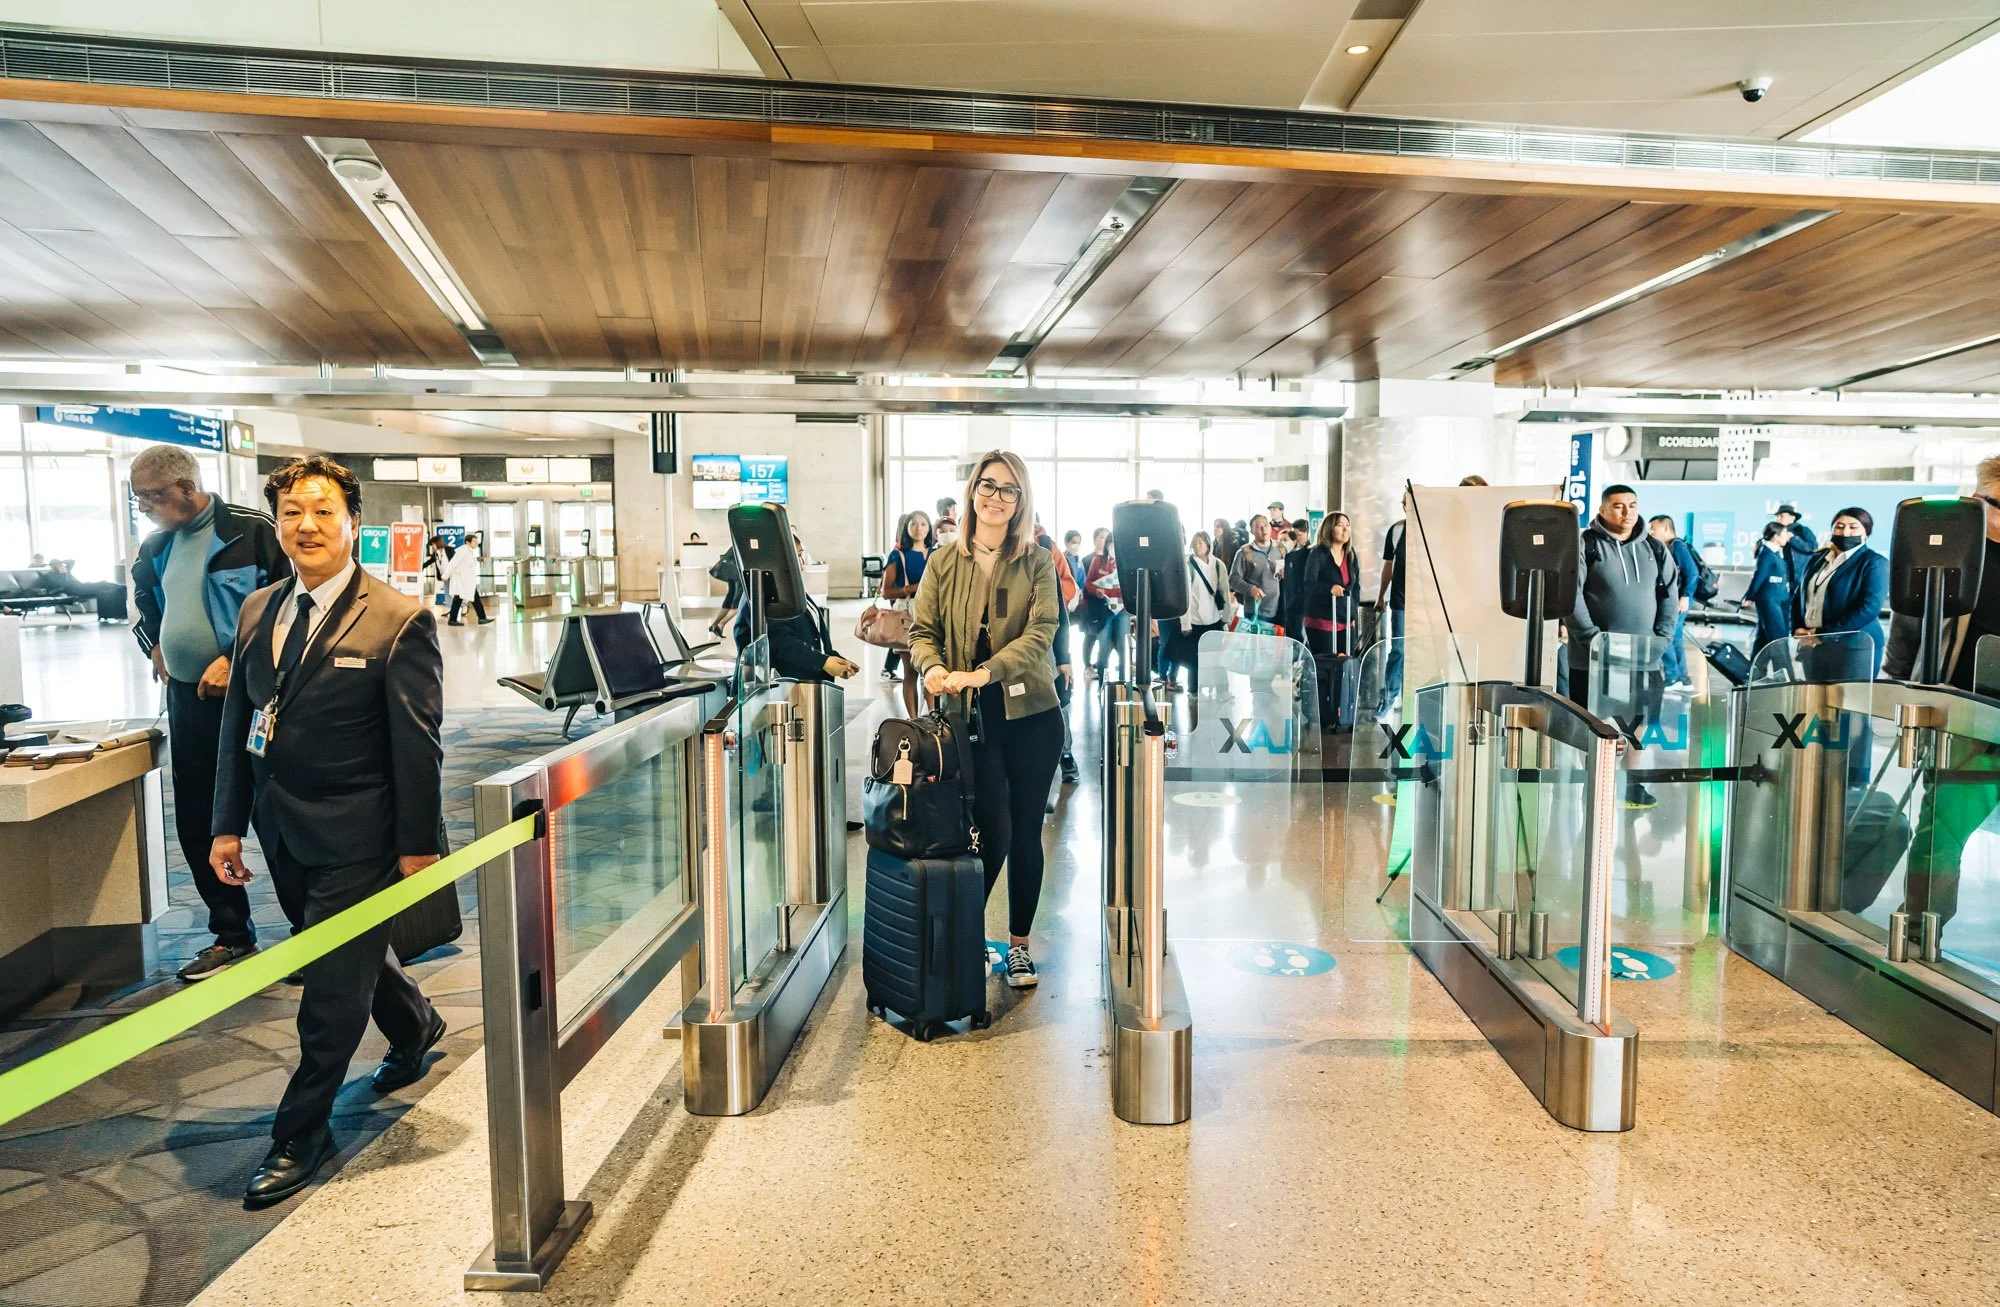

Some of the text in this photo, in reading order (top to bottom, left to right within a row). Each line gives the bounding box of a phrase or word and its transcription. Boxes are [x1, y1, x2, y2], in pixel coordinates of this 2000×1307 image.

[1658, 436, 1720, 447] SCOREBOAR
[749, 464, 776, 478] 157
[363, 529, 388, 537] GROUP
[394, 526, 422, 534] GROUP
[438, 528, 464, 536] GROUP
[371, 538, 379, 548] 4
[404, 535, 411, 547] 1
[447, 536, 456, 547] 2
